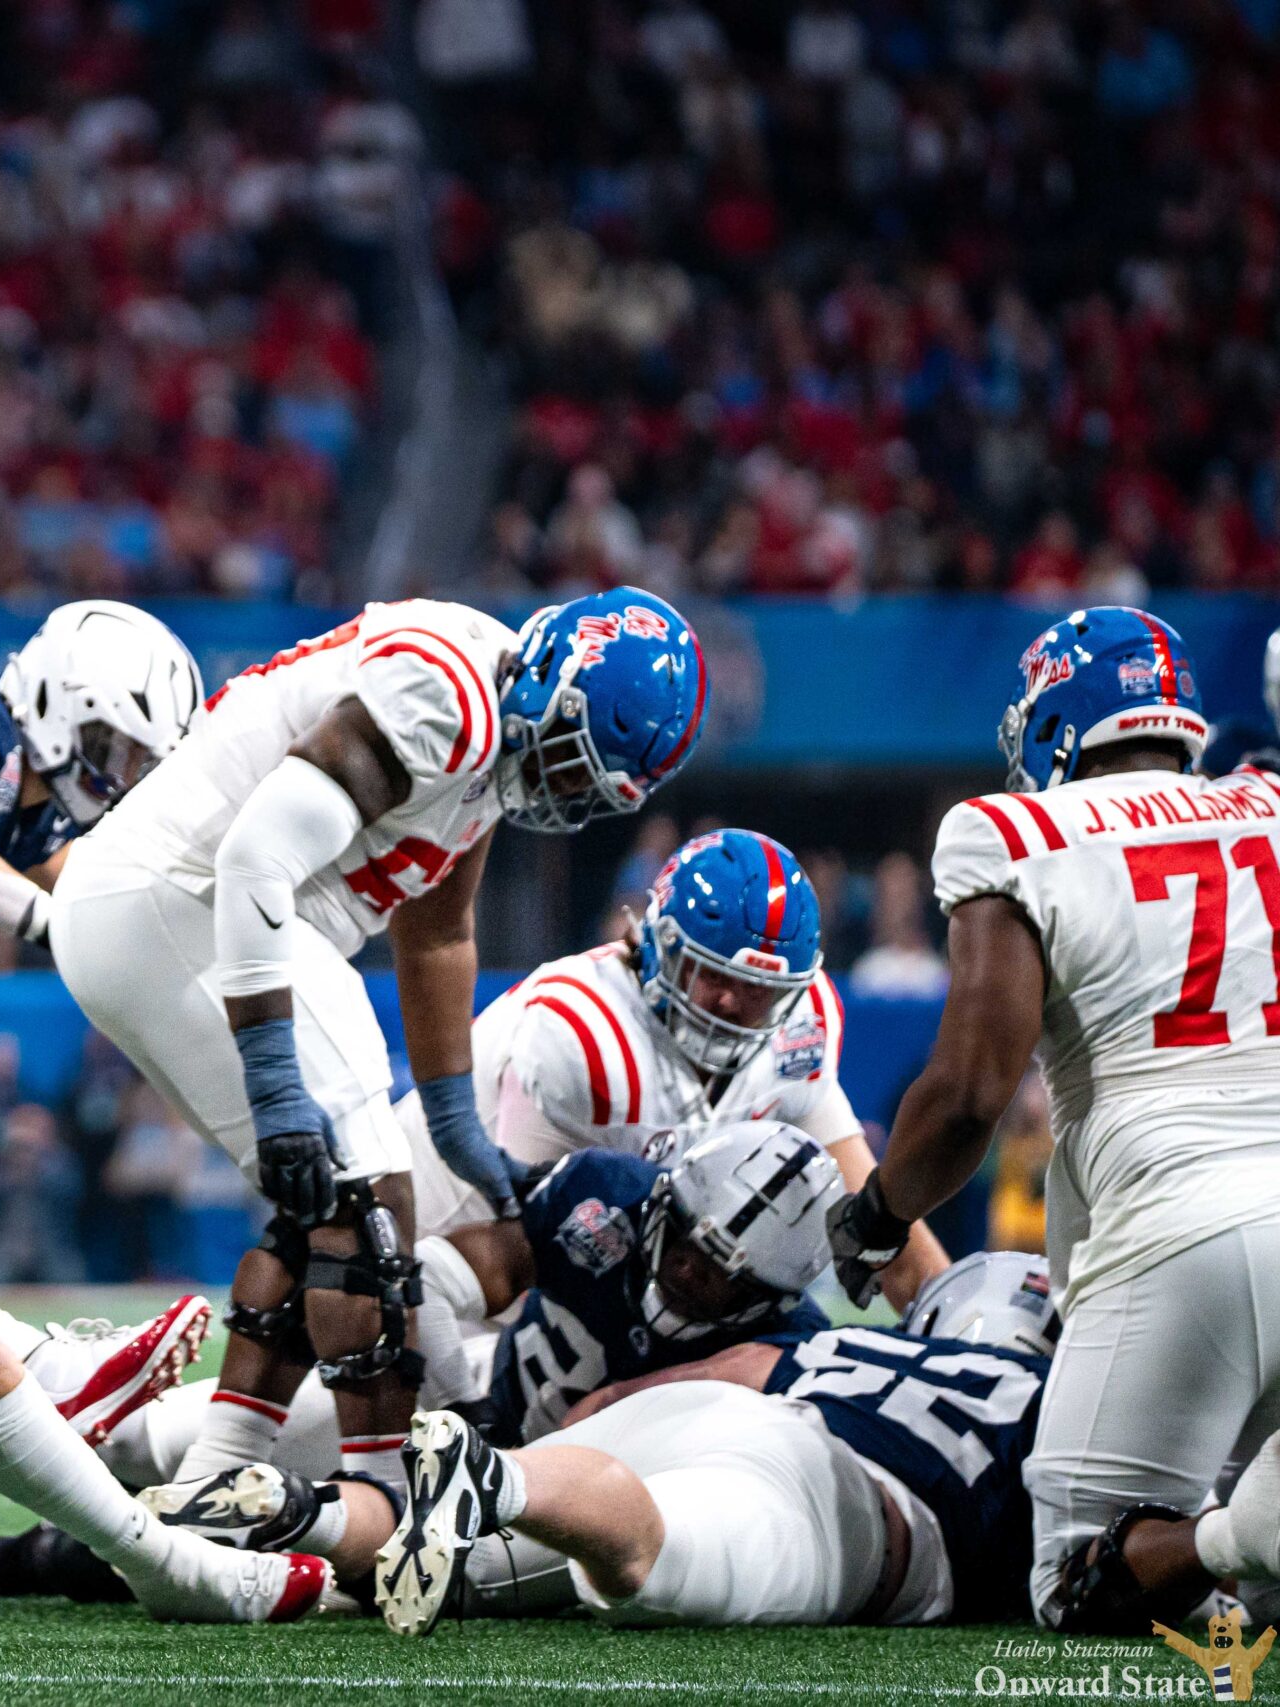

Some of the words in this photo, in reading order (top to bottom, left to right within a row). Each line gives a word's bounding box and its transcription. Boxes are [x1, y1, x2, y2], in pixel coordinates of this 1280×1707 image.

[1084, 799, 1116, 834] J.
[1108, 784, 1276, 829] WILLIAMS
[1122, 834, 1280, 1048] 71
